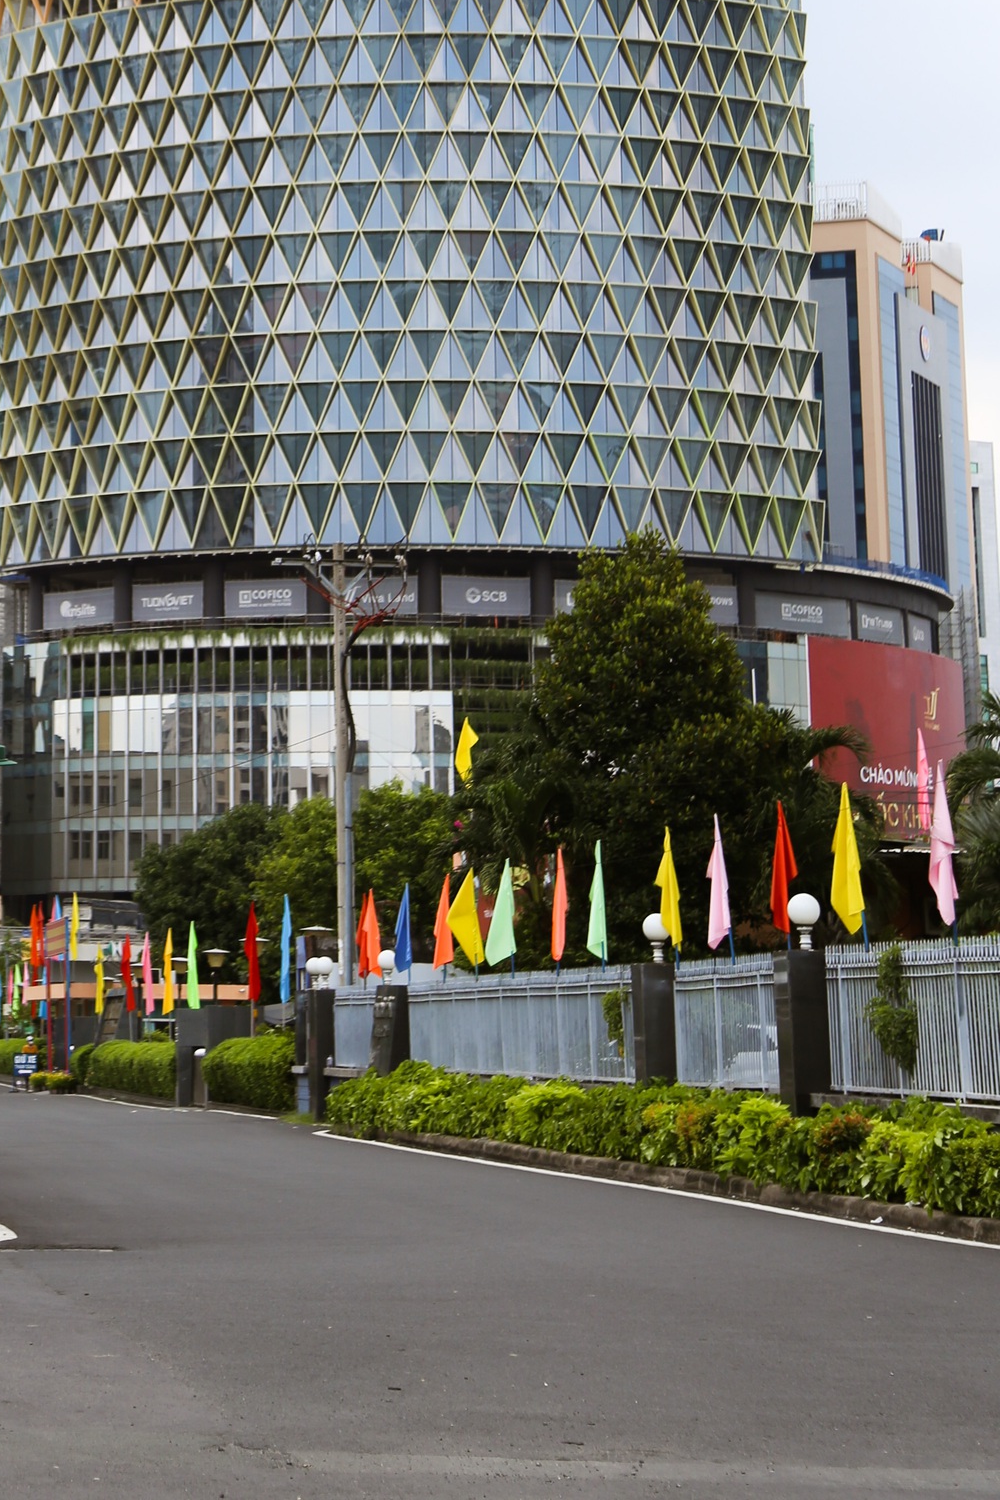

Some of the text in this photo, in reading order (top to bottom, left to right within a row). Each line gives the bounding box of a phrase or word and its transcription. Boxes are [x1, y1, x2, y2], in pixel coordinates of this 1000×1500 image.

[251, 588, 292, 600] COFICO
[481, 590, 507, 602] SCB
[791, 604, 823, 616] COFICO
[859, 763, 894, 785] CHÀO
[894, 766, 918, 788] MỪN
